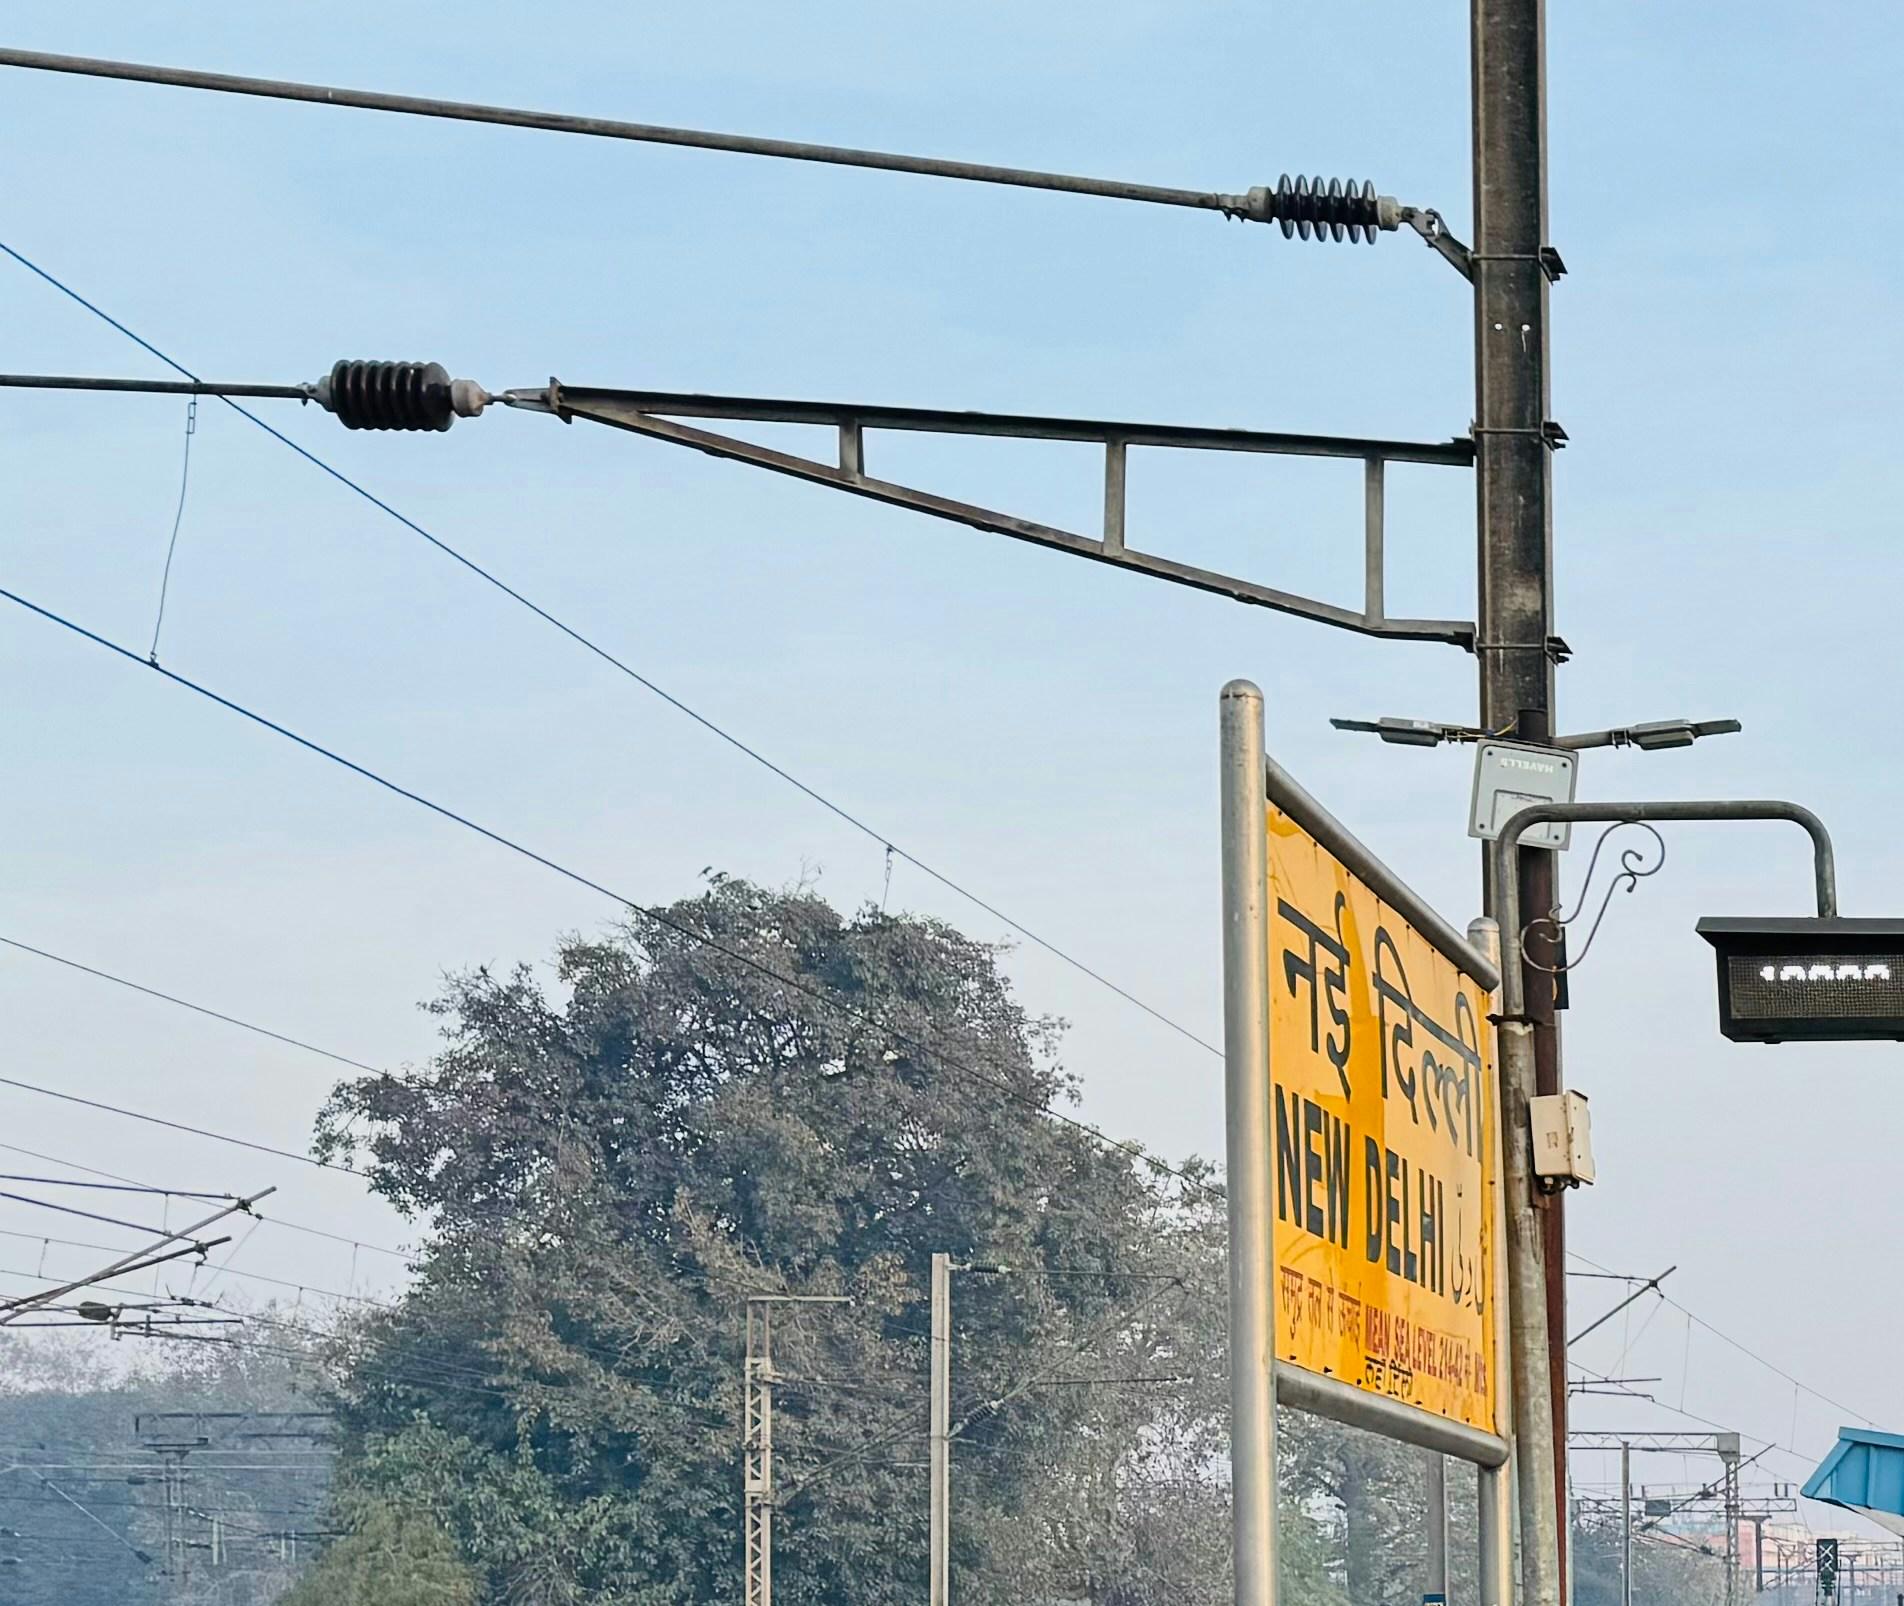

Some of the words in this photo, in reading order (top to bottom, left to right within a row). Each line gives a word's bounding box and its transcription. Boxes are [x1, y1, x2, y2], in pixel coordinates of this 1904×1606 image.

[1500, 758, 1554, 774] HAVELLS
[1277, 890, 1351, 1103] नई
[1372, 926, 1482, 1163] दिल्ली
[1275, 1083, 1351, 1250] NEW
[1365, 1135, 1444, 1297] DELHI
[1395, 1315, 1412, 1372] SEA
[1412, 1324, 1437, 1378] LEVEL
